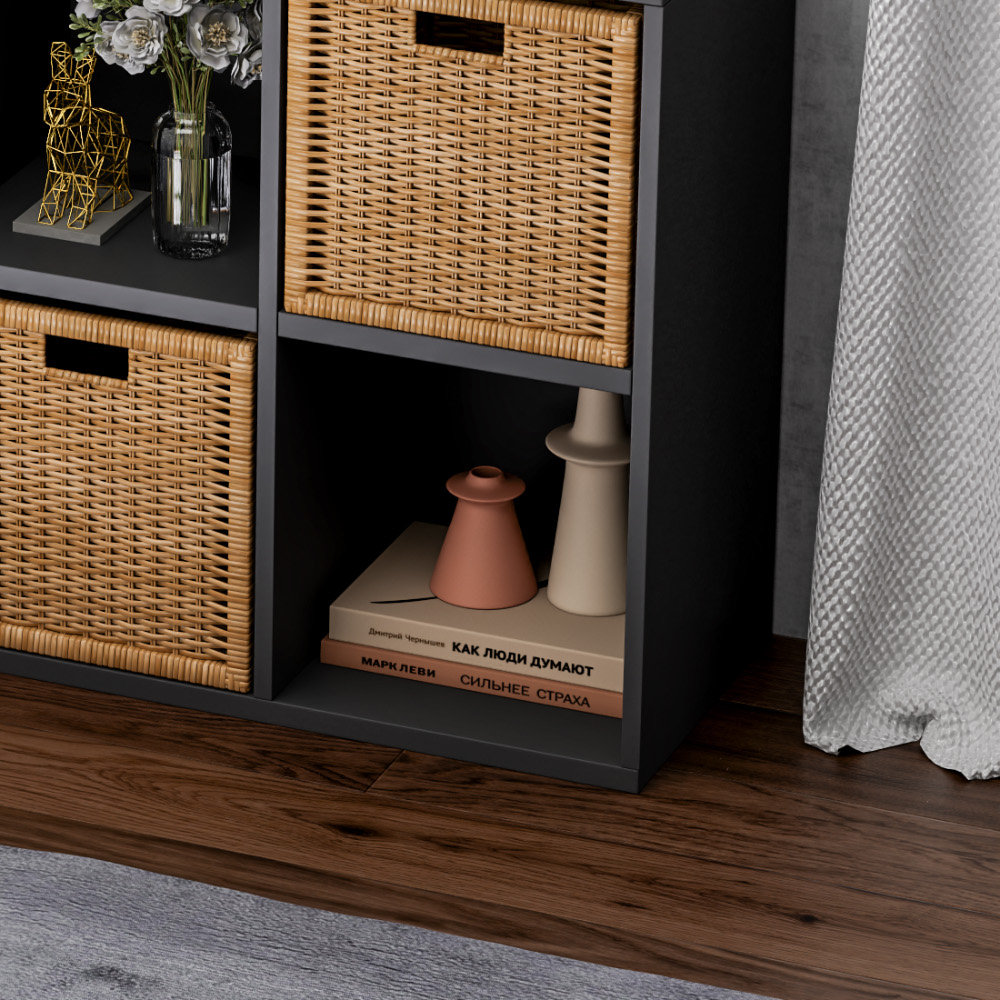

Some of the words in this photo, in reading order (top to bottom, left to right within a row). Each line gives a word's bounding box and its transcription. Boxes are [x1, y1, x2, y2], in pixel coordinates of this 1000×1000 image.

[368, 627, 403, 640] Дмитрий
[405, 634, 446, 648] Чернышев
[361, 656, 398, 671] МАРК
[400, 663, 436, 678] ЛЕВИ
[452, 641, 480, 656] КАК
[483, 647, 527, 665] ЛЮДИ
[530, 656, 594, 677] ДУМАЮТ
[460, 674, 530, 697] СИЛЬНЕЕ
[537, 688, 591, 708] СТРАХА
